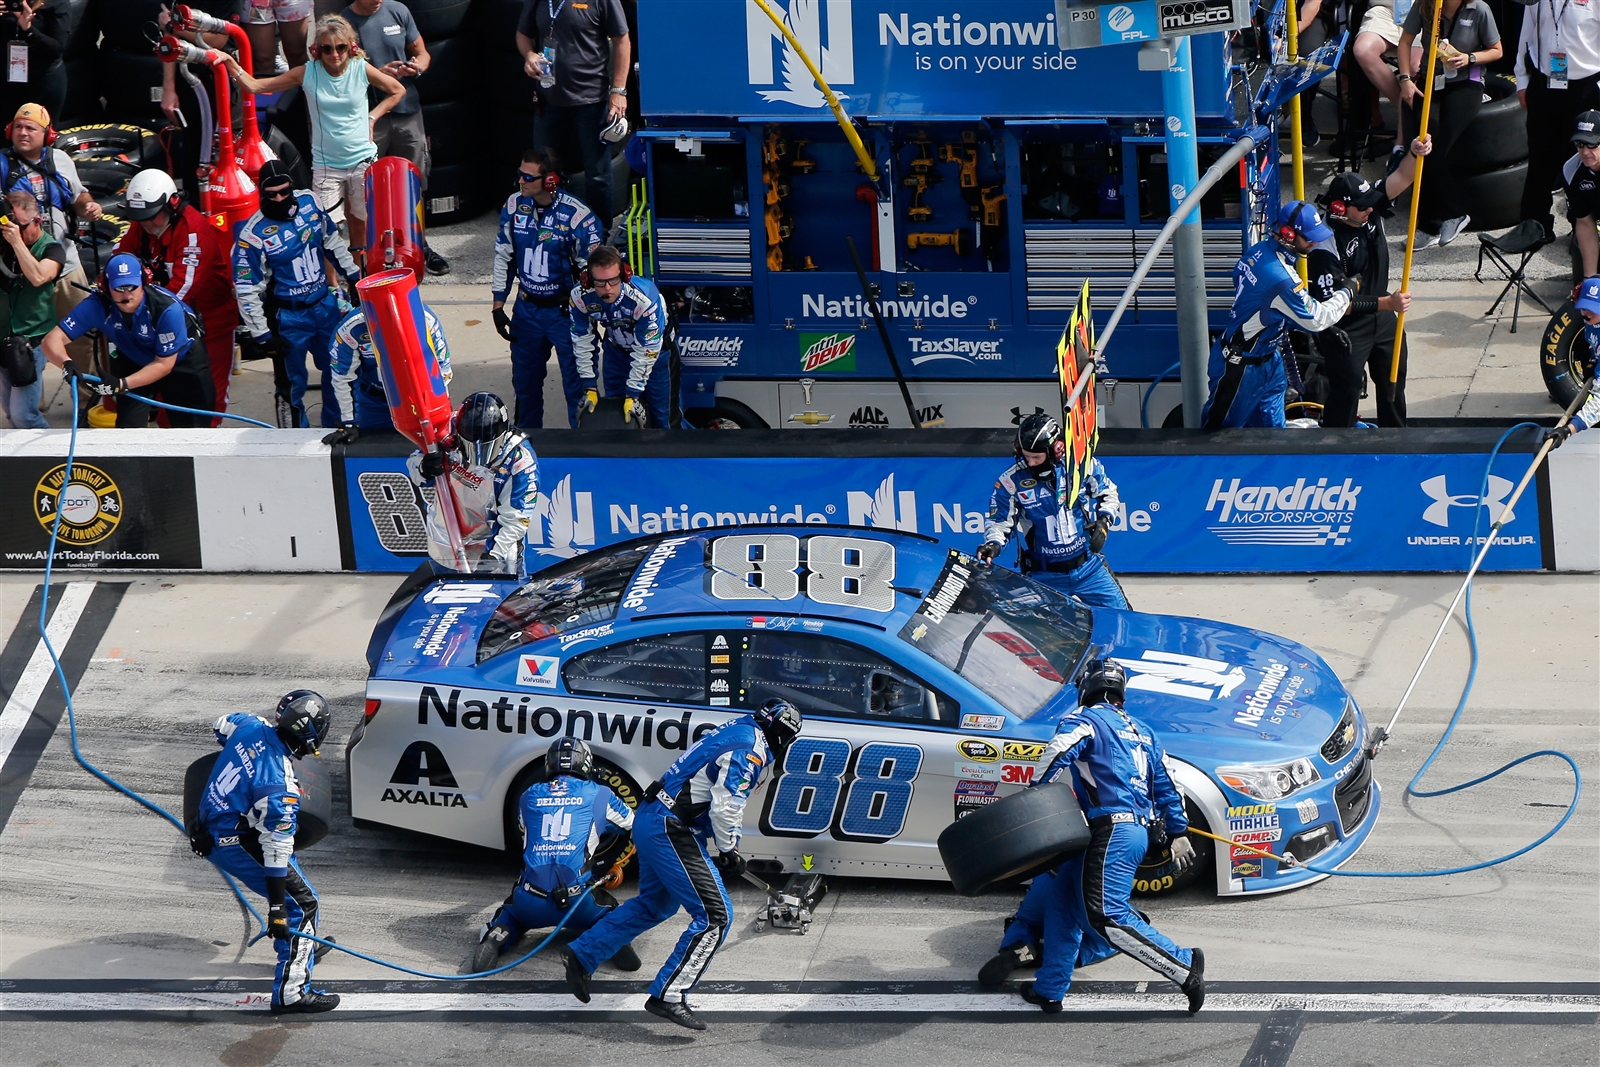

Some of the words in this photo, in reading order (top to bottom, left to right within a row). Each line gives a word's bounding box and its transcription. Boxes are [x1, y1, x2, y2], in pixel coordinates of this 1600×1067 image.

[1072, 13, 1080, 21] P
[1084, 11, 1096, 20] 30
[878, 13, 1056, 46] Nationwi
[1121, 31, 1148, 40] FPL
[915, 52, 932, 70] is
[939, 56, 967, 70] on
[975, 56, 1026, 73] your
[1031, 51, 1077, 70] side
[209, 184, 226, 193] FUEL
[216, 215, 224, 226] 3
[1317, 273, 1334, 288] 48
[908, 337, 1000, 357] TaxSlayer
[1545, 312, 1572, 366] EAGLE
[849, 406, 890, 424] MAC
[72, 467, 106, 488] TONIGHT
[1205, 478, 1362, 522] Hendrick
[1231, 511, 1353, 523] MOTORSPORTS
[71, 519, 108, 540] TOMORROW
[1041, 536, 1087, 555] Nationwide
[1407, 536, 1460, 545] UNDER
[5, 550, 160, 562] www.AlrtTodayFlorida.com
[623, 537, 691, 608] Nationwide
[711, 534, 896, 613] 88
[923, 572, 966, 625] EARNHARDT
[952, 563, 972, 579] JR
[420, 624, 433, 638] your
[422, 606, 468, 656] Nationwide
[559, 622, 614, 644] TaxSlayer
[412, 637, 427, 649] side
[522, 676, 551, 684] Valvoline
[710, 679, 729, 688] MAC
[1286, 675, 1305, 689] side
[1233, 663, 1290, 728] Nationwide
[1279, 687, 1297, 706] your
[417, 686, 715, 752] Nationwide
[1274, 704, 1288, 716] on
[1266, 716, 1282, 725] is
[234, 742, 256, 778] HARRELL
[1001, 765, 1034, 783] 3M
[764, 735, 924, 840] 88
[960, 781, 994, 791] Duralast
[381, 787, 468, 808] AXALTA
[536, 797, 583, 807] DELRICCO
[1227, 803, 1277, 818] MOOG
[1230, 815, 1278, 830] MAHLE
[1233, 832, 1271, 842] COMP
[533, 843, 576, 852] Nationwide
[691, 932, 717, 968] Nationwide
[1139, 949, 1177, 976] Nationwide
